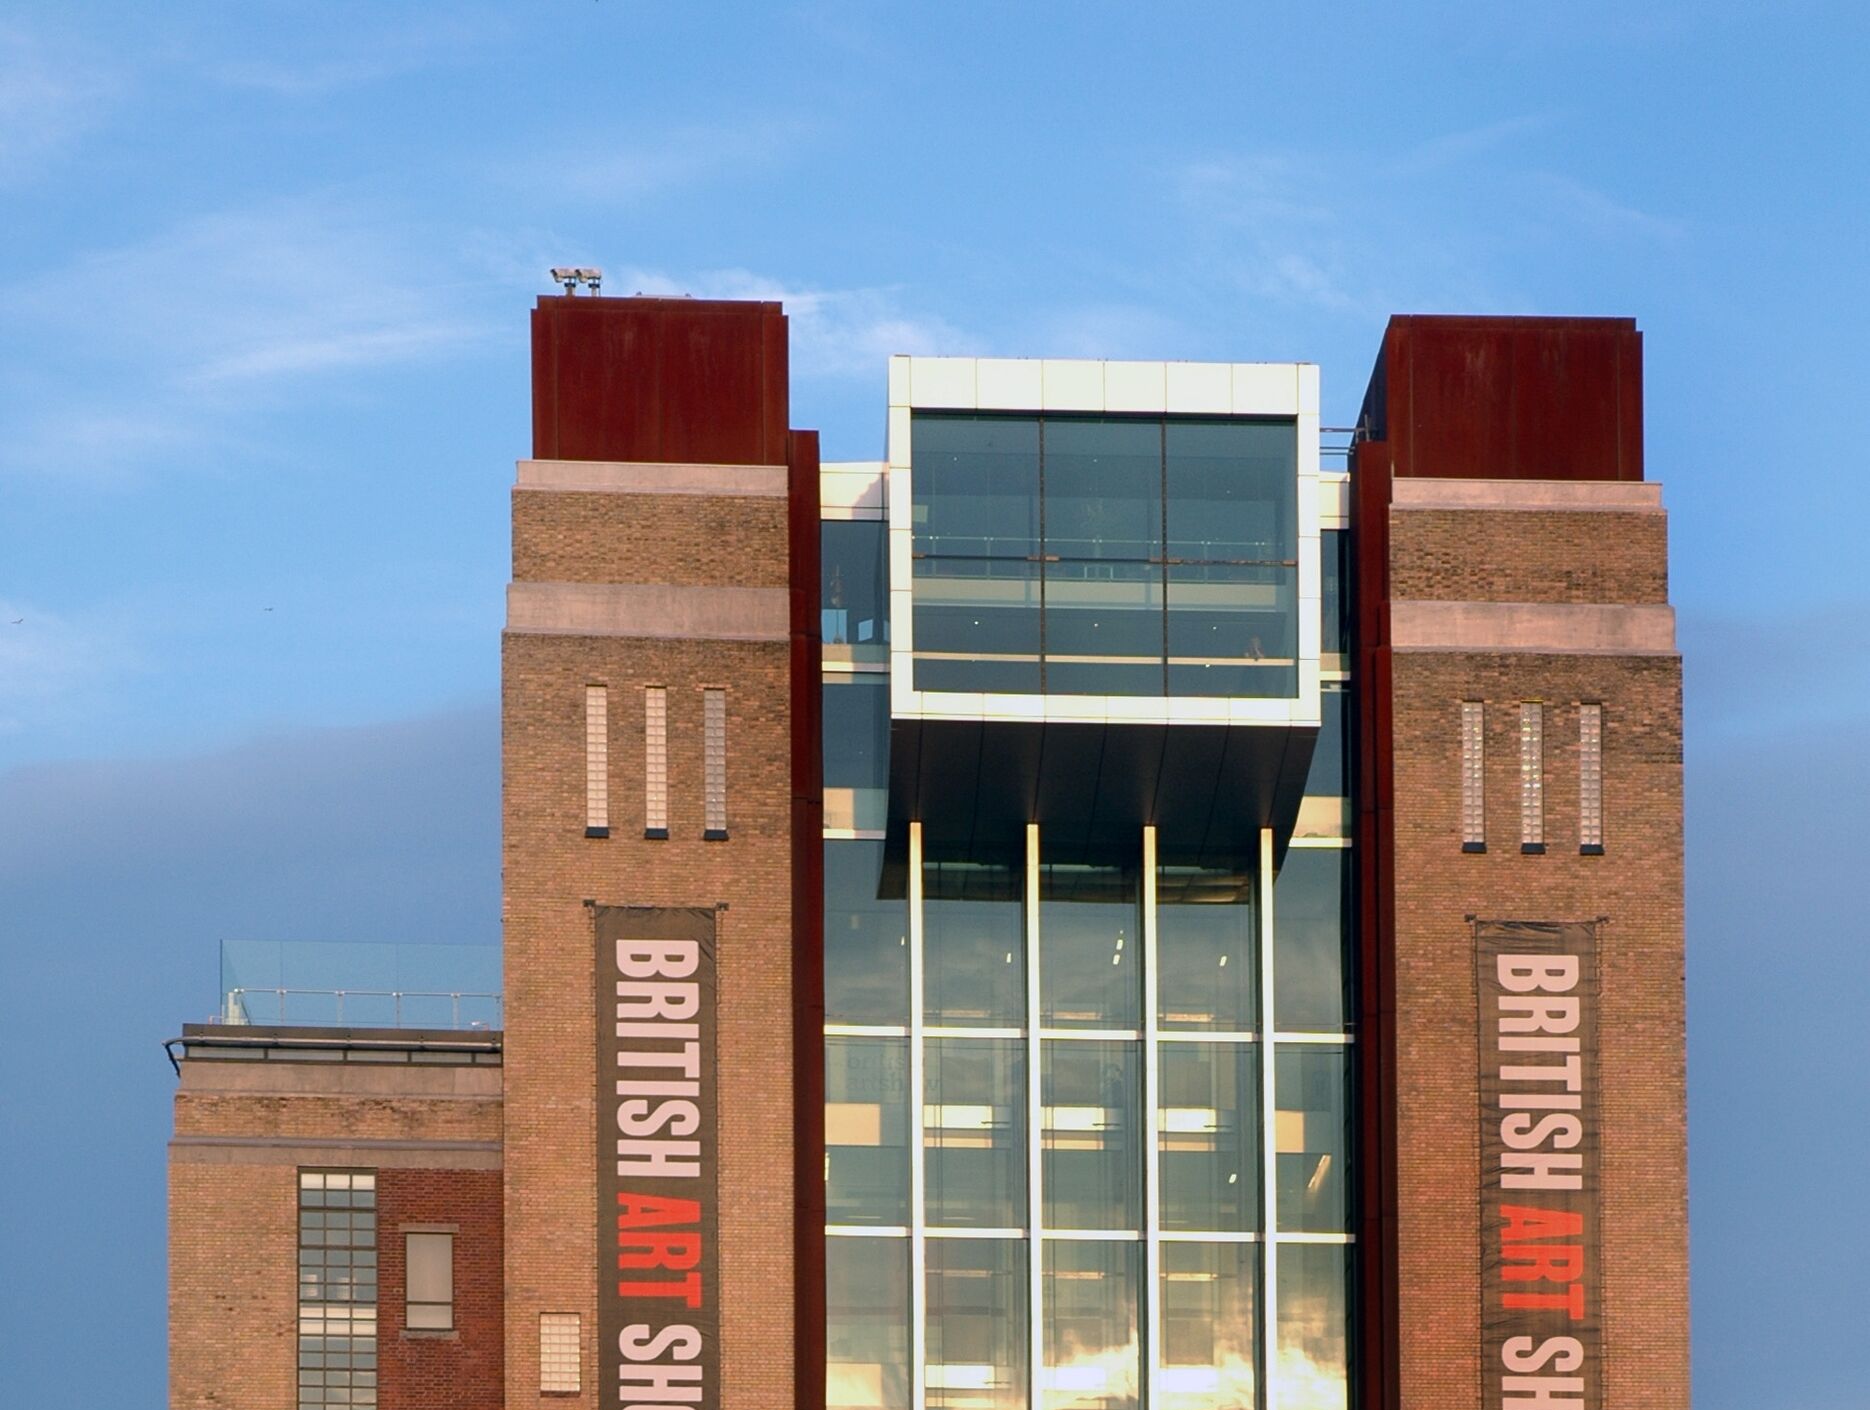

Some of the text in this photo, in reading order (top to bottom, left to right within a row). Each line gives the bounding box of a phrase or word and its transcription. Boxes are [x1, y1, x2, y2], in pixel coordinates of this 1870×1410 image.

[616, 939, 700, 1177] BRITISH
[1497, 955, 1582, 1189] BRITISH
[617, 1192, 702, 1309] ART
[1499, 1204, 1585, 1320] ART
